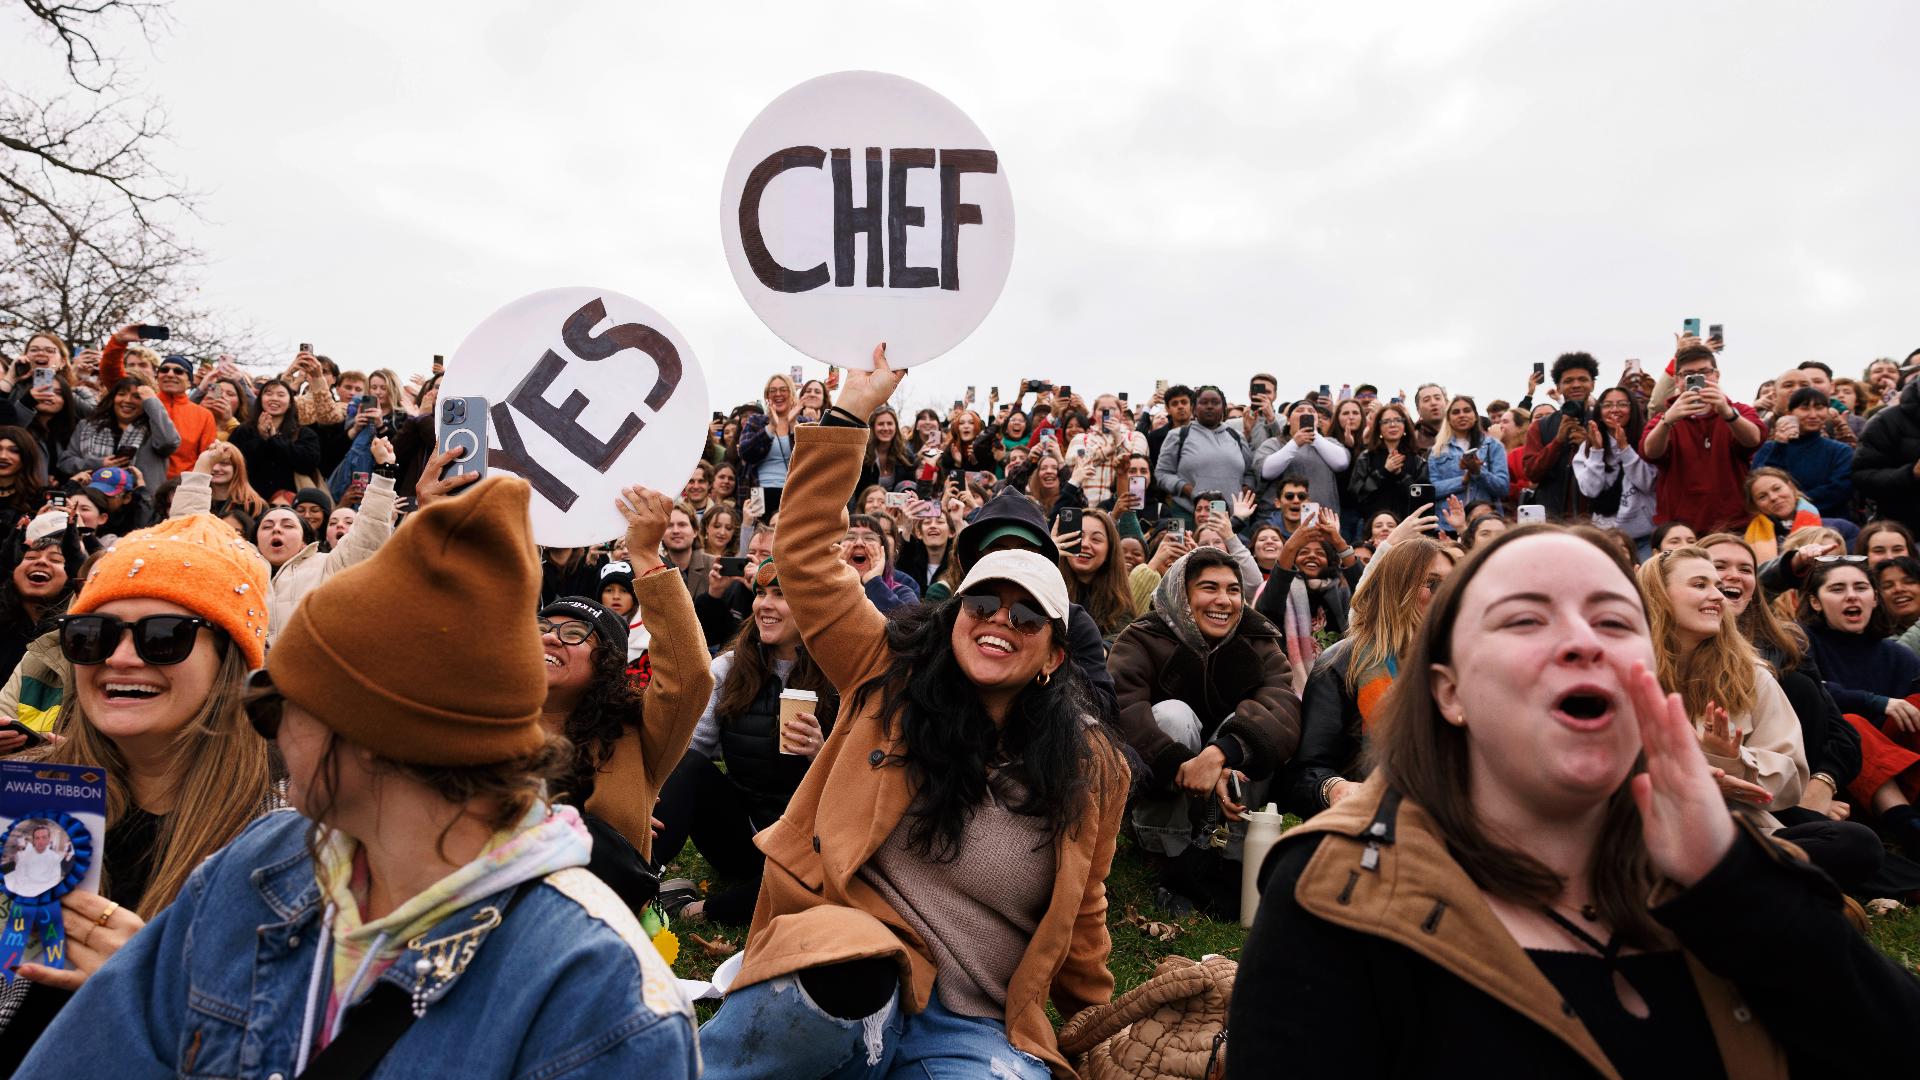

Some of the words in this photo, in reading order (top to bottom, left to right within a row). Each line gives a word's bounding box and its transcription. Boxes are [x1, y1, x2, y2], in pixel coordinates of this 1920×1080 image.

[739, 145, 998, 293] CHEF
[488, 297, 683, 513] YES
[5, 781, 52, 795] AWARD
[55, 784, 102, 798] RIBBON
